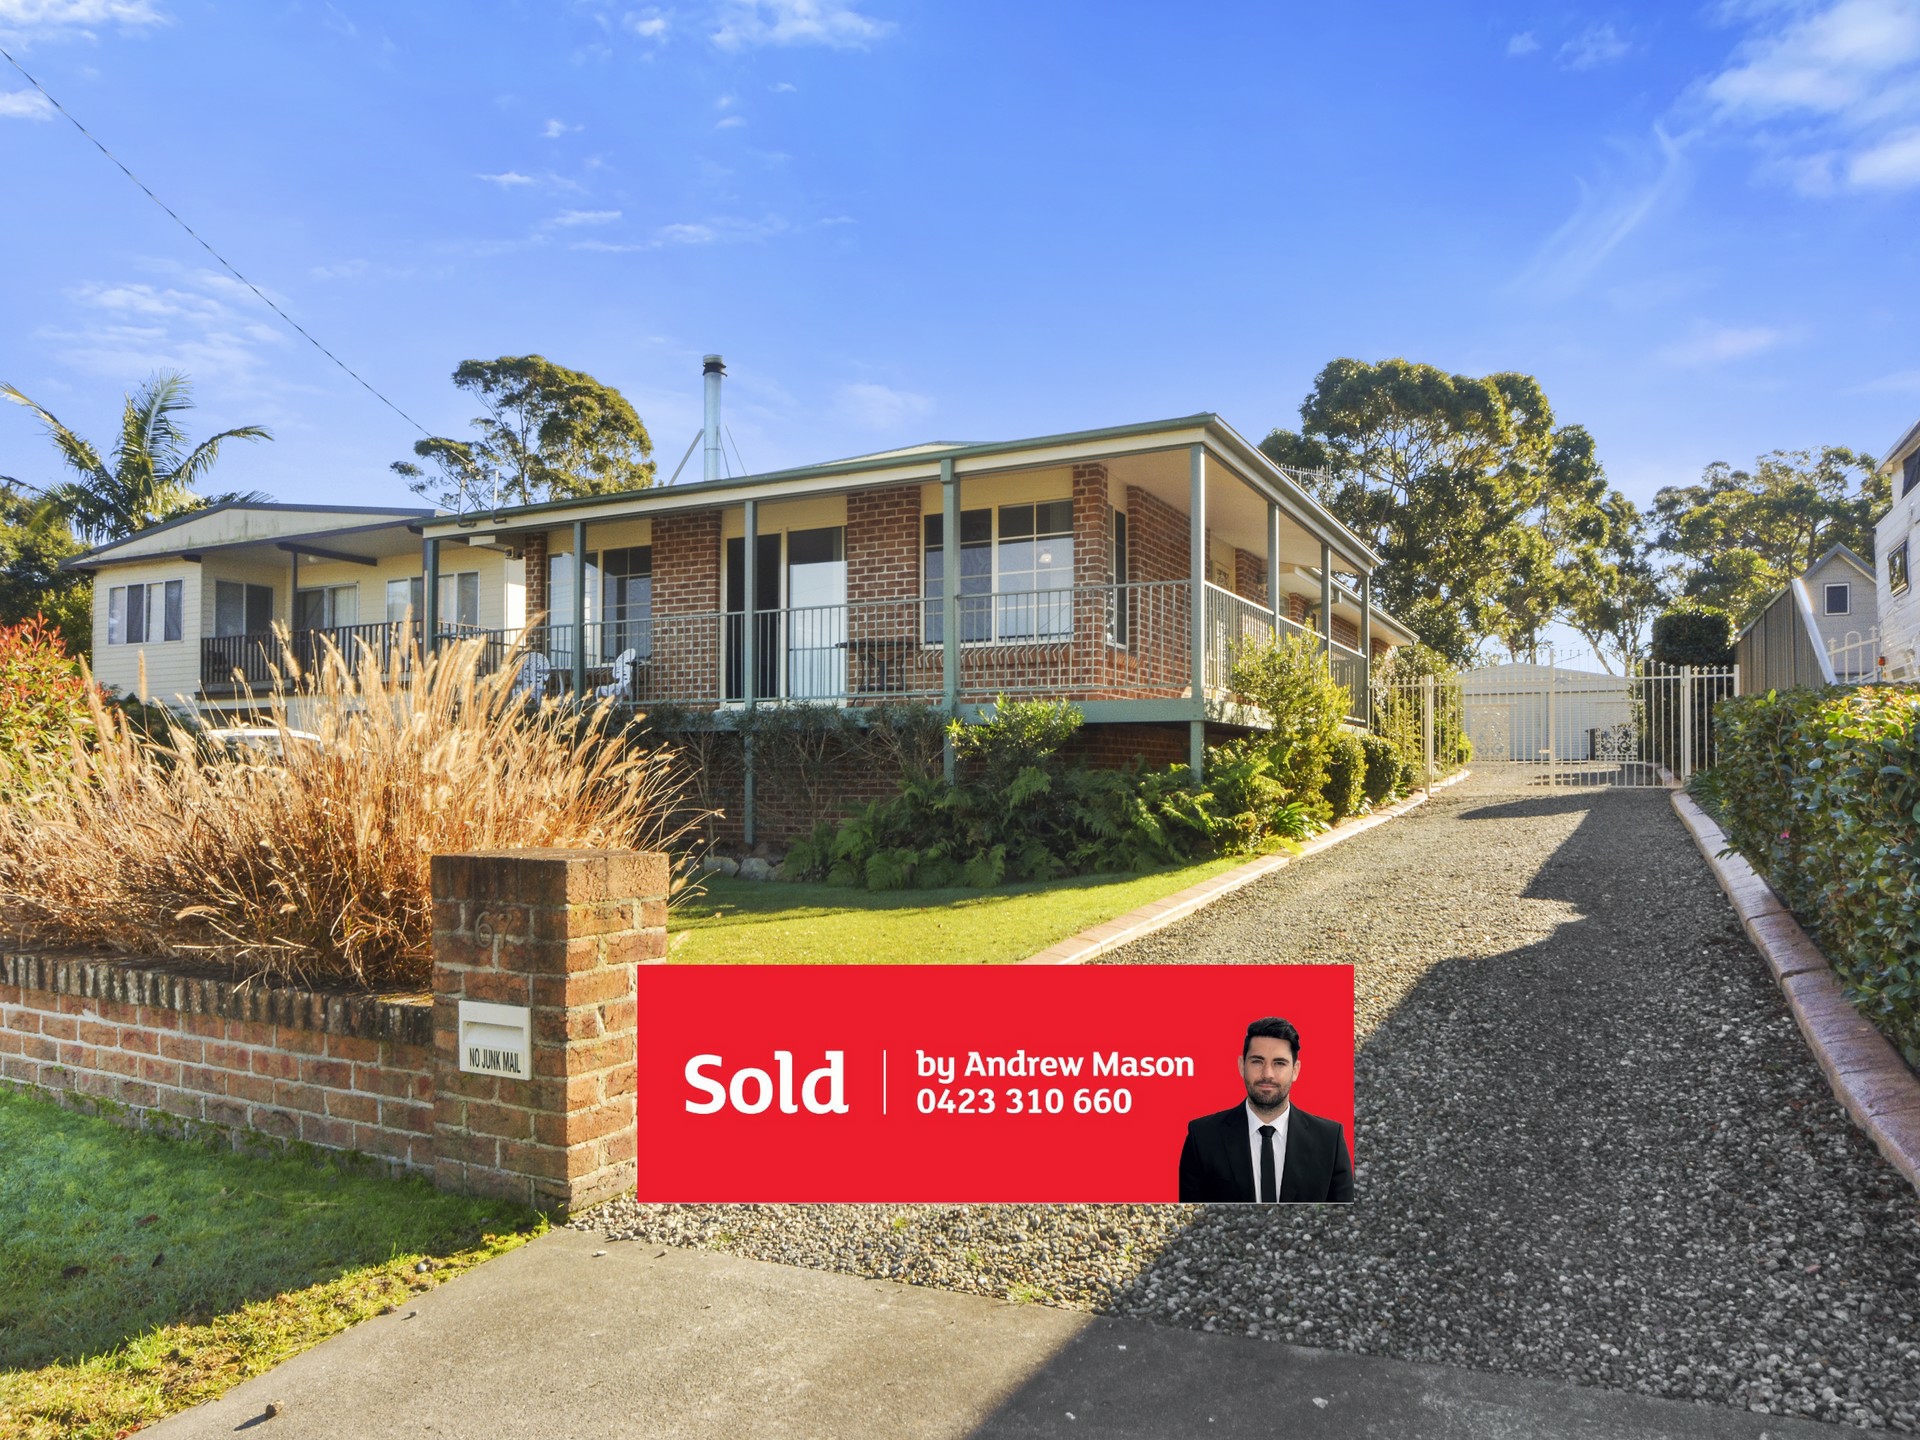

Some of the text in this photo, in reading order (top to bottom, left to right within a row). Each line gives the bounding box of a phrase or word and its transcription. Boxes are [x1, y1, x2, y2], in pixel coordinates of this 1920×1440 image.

[475, 911, 513, 949] 67
[469, 1047, 521, 1074] NO JUNK MAIL
